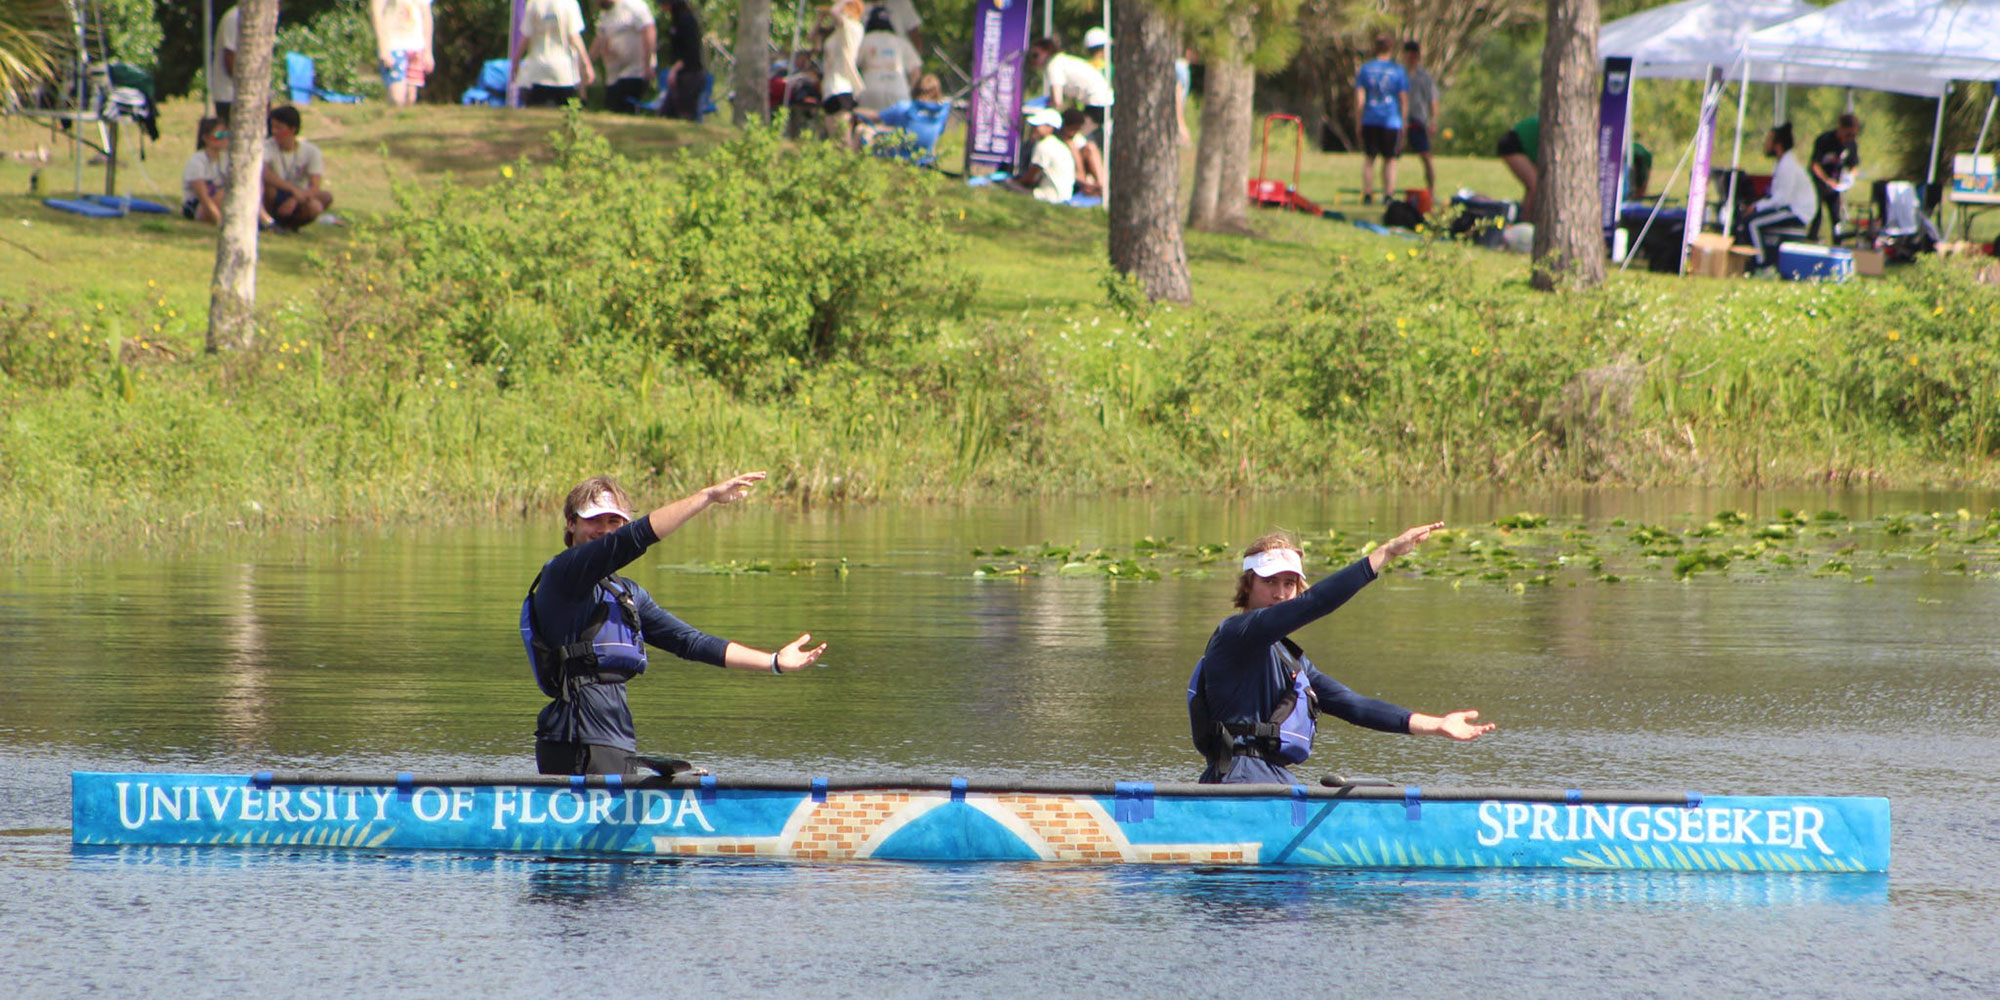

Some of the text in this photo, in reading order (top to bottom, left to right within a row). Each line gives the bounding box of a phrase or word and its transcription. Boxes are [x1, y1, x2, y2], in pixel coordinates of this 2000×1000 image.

[115, 782, 715, 831] UNIVERSITY OF FLORIDA
[1477, 800, 1834, 855] SPRINGSEEKER
